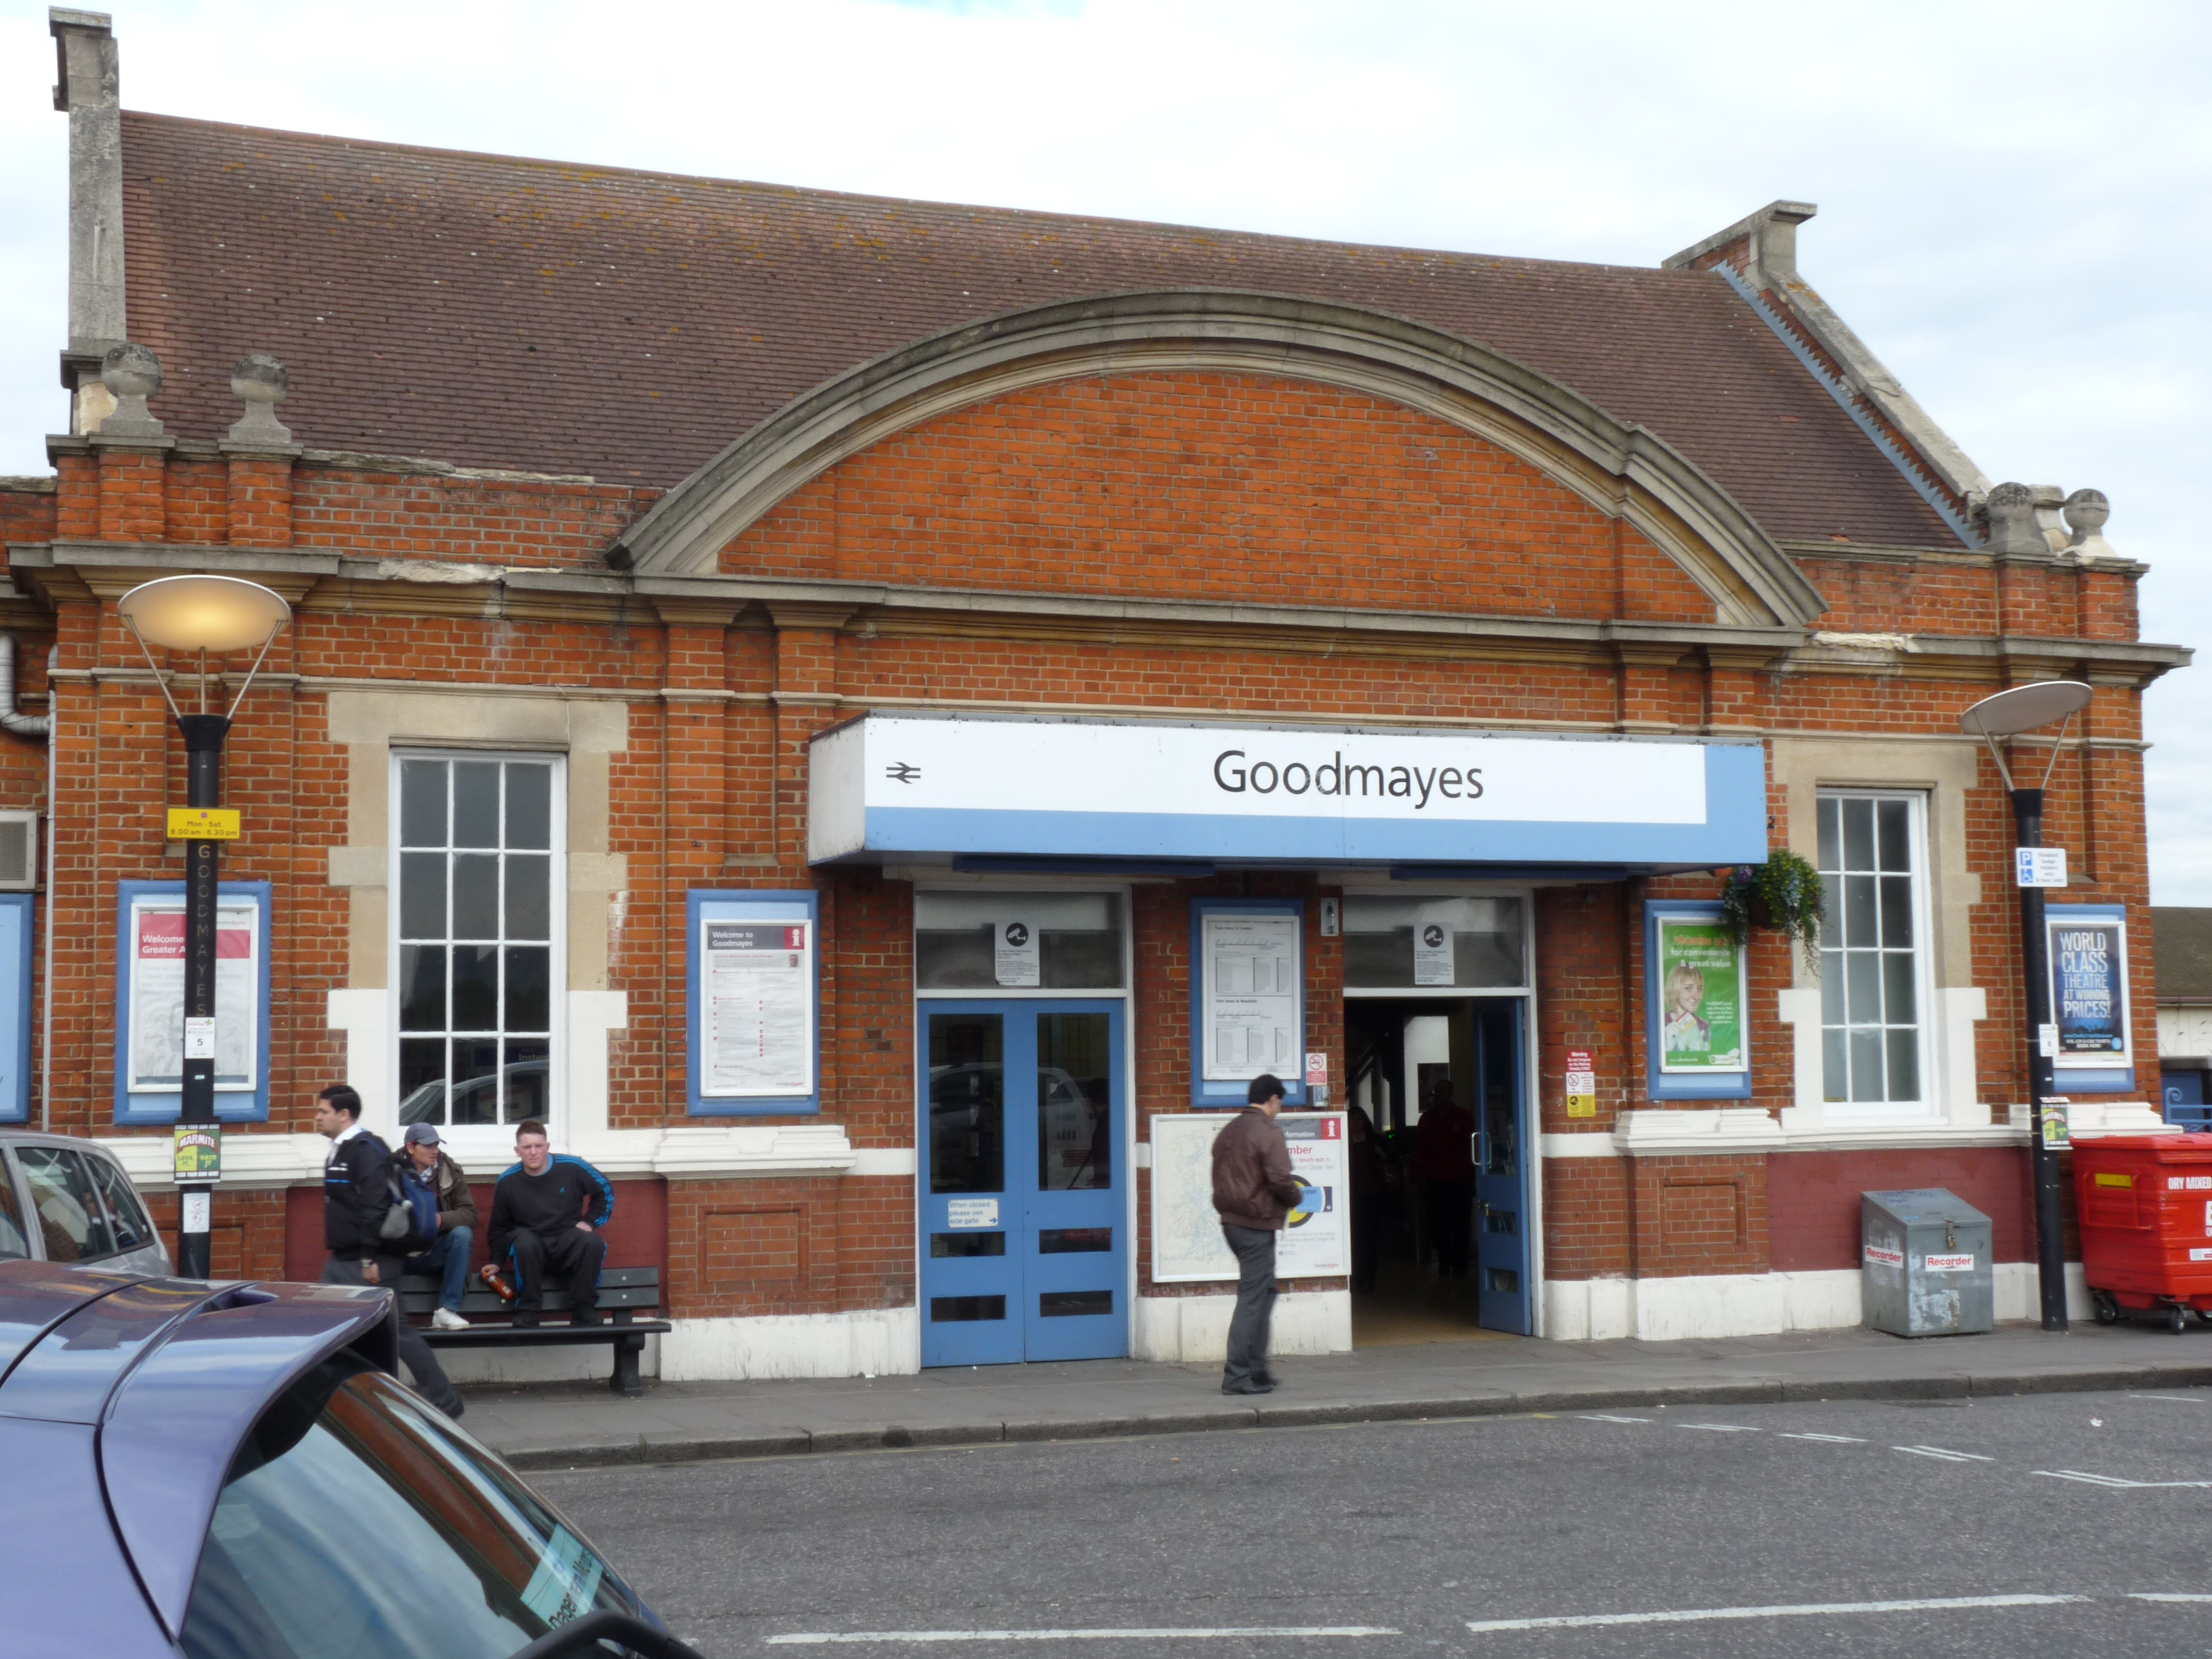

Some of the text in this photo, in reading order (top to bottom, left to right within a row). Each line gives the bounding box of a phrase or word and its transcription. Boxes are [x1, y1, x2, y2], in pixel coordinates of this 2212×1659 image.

[1213, 749, 1484, 809] Goodmayes
[2022, 852, 2031, 866] P
[142, 934, 184, 943] Welcome
[712, 940, 753, 948] Goodmayes
[2059, 931, 2107, 951] WORLD
[142, 945, 176, 954] Greater
[1670, 947, 1683, 956] for
[1680, 959, 1686, 967] &
[1688, 960, 1710, 969] great
[2062, 950, 2108, 973] CLASS
[2062, 973, 2108, 989] THEATRE
[2063, 989, 2110, 1001] AT WINNING
[2063, 1000, 2112, 1019] PRICES!
[178, 1133, 215, 1148] MARMITE
[1287, 1144, 1313, 1155] mber
[2168, 1176, 2212, 1190] DRY MIXED
[1866, 1247, 1902, 1262] Recorder
[1927, 1256, 1972, 1266] Recorder
